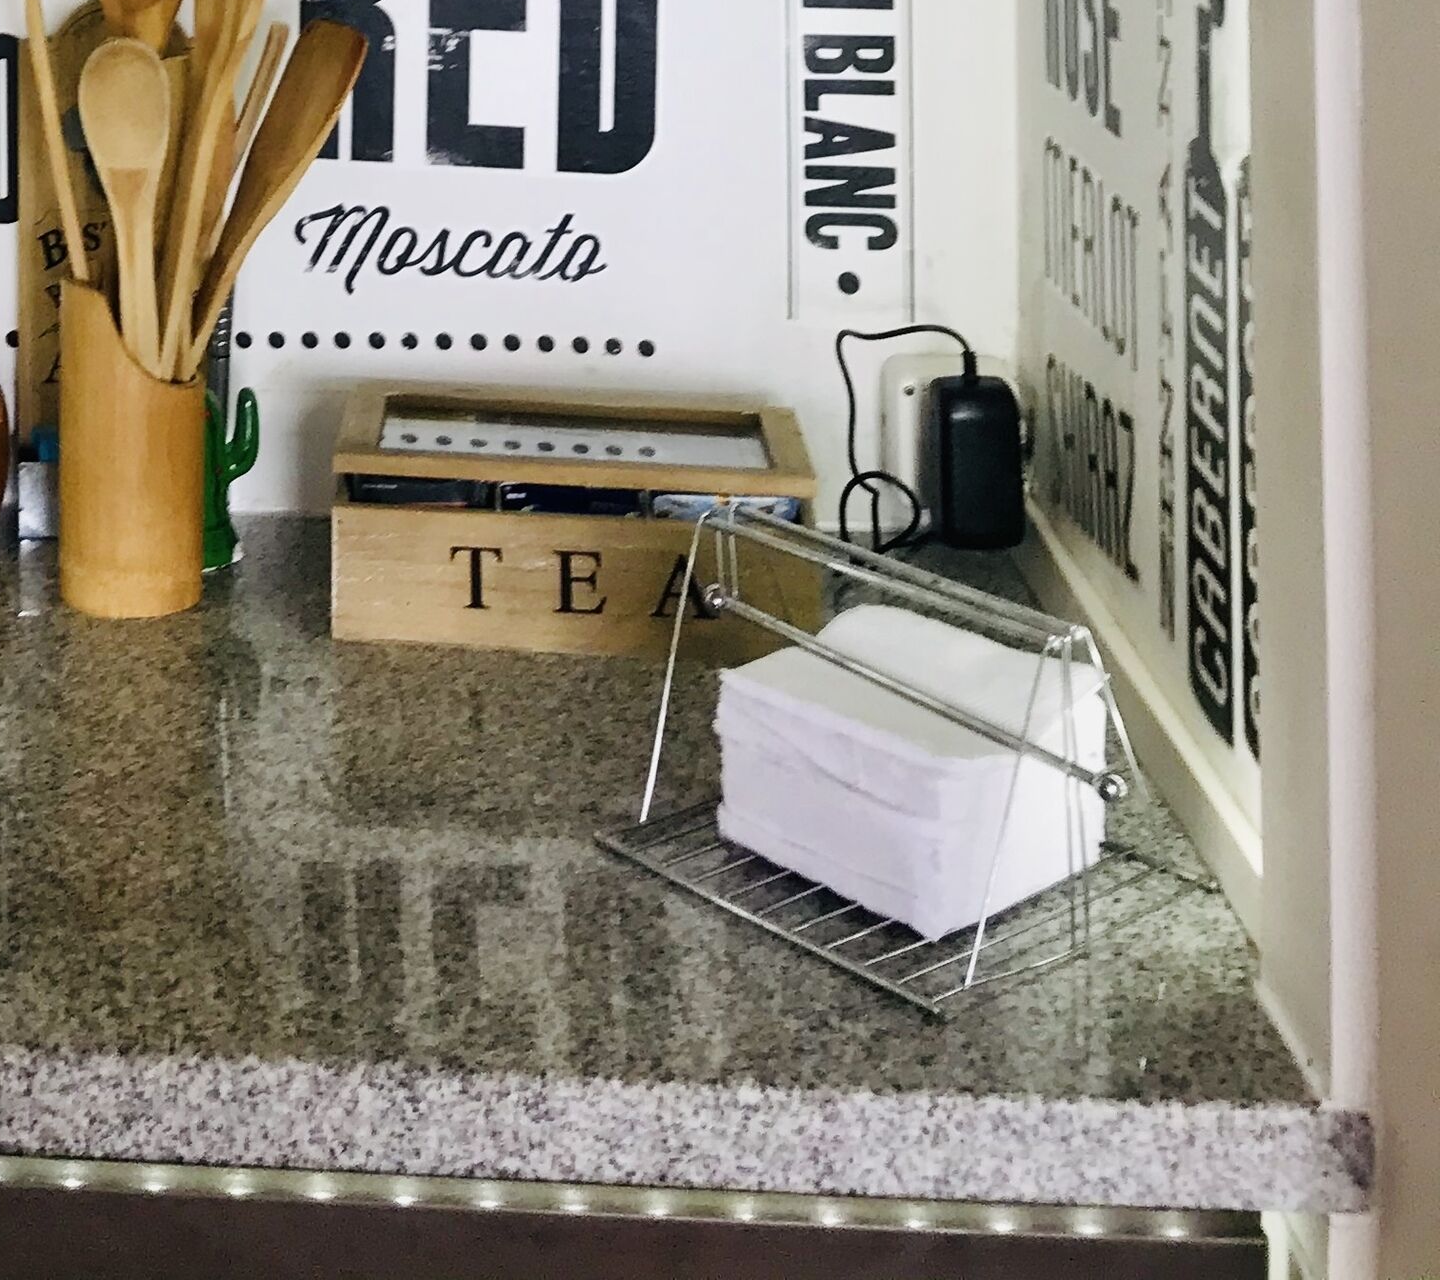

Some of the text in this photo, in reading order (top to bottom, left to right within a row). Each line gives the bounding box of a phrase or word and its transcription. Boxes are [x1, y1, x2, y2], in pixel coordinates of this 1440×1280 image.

[803, 35, 899, 252] BLANC
[294, 202, 608, 295] Moscato
[1191, 174, 1228, 708] CABERNET
[449, 545, 721, 620] TEA
